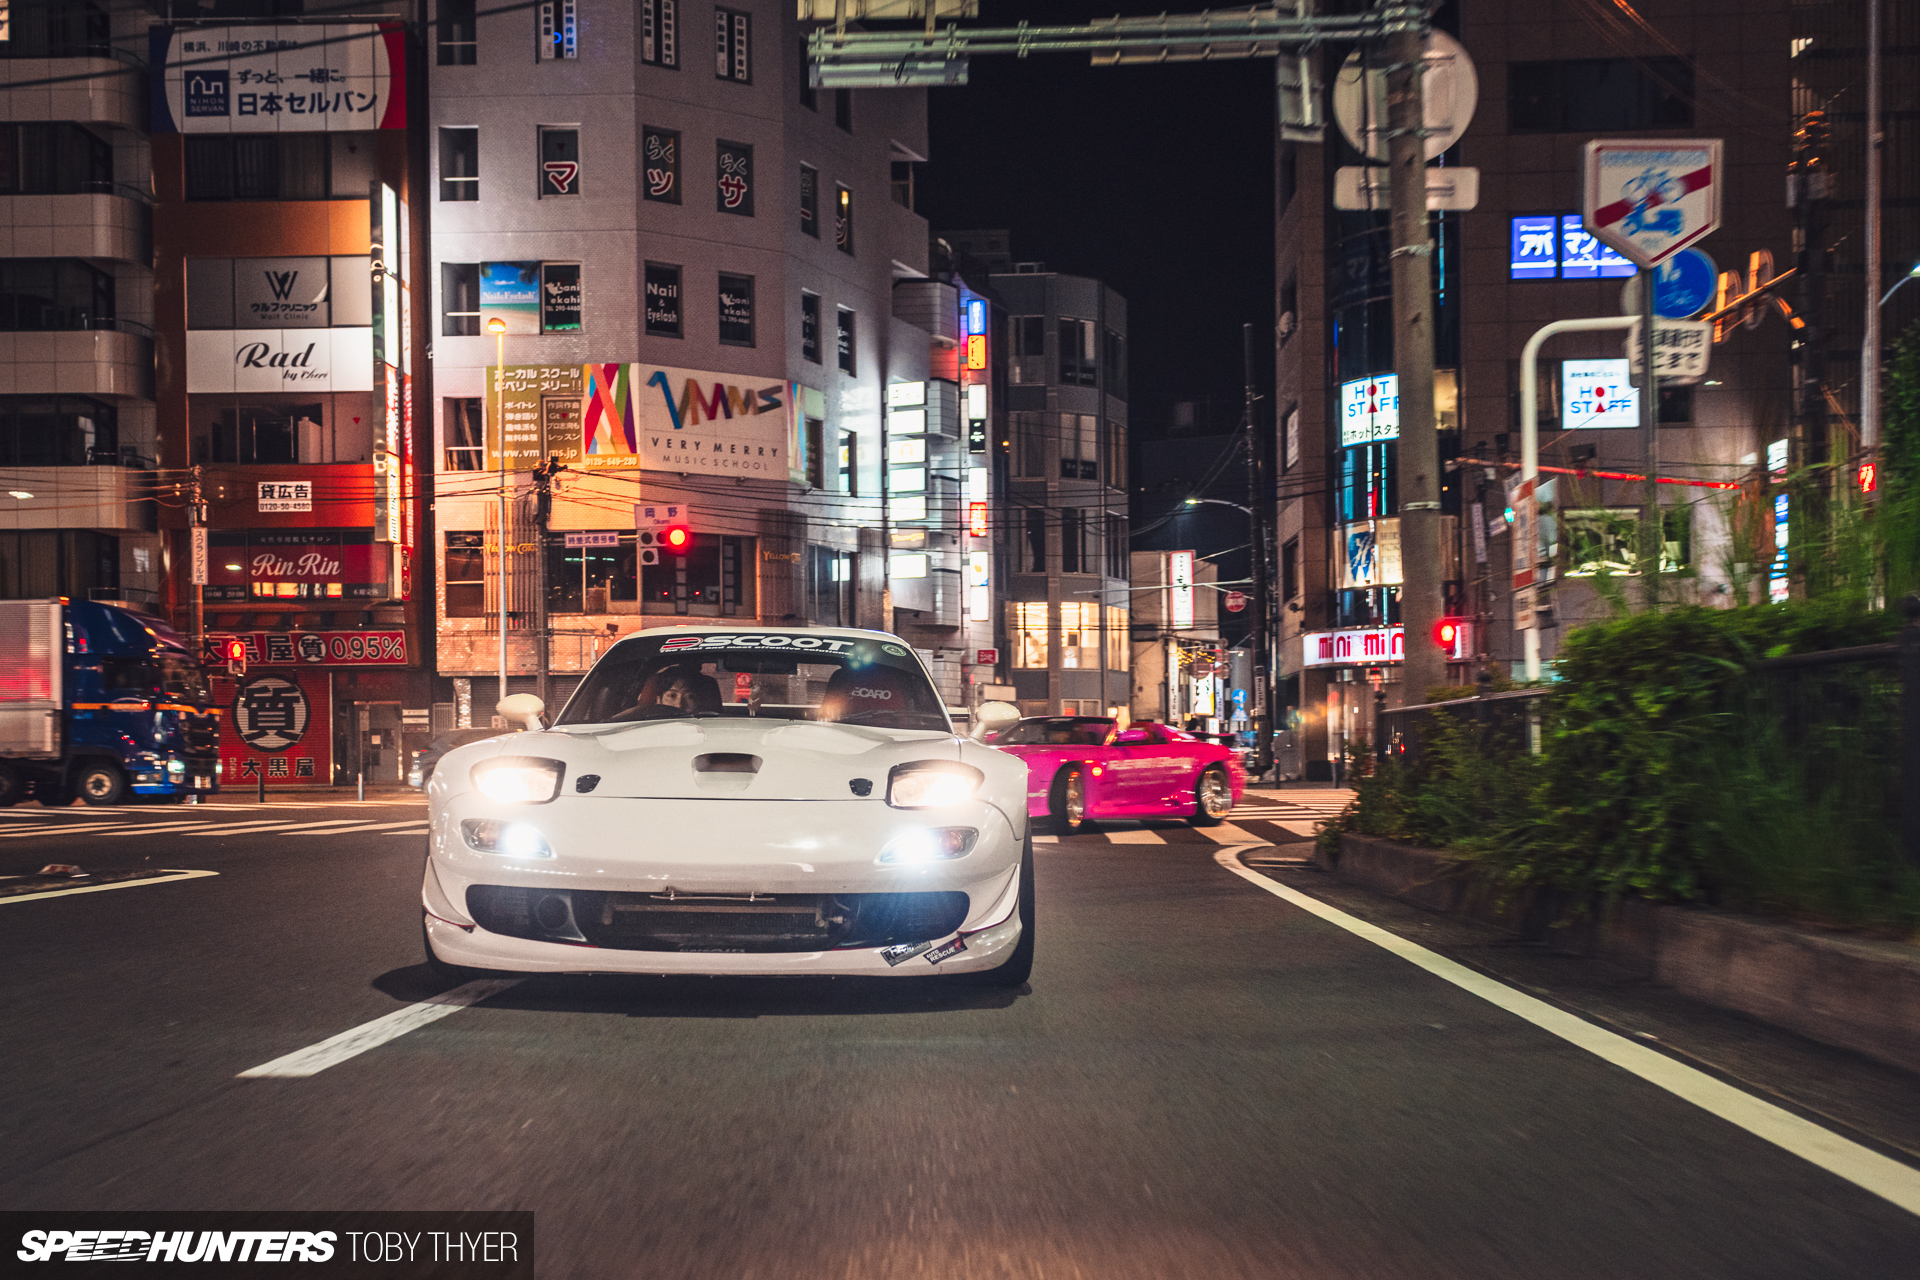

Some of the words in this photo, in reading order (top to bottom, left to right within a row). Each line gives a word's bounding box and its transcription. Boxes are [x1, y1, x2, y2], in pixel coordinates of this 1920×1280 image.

[238, 68, 346, 84] ずっと、一緒に。
[190, 105, 225, 113] SERVAN
[238, 91, 378, 116] 日本セルバン
[718, 174, 748, 208] サ
[646, 282, 678, 298] Nail
[251, 302, 318, 313] ウルフクリニック
[647, 307, 678, 323] Eyelash
[236, 342, 317, 369] Rad
[283, 369, 298, 381] by
[540, 368, 580, 379] スクール
[1354, 380, 1390, 400] HOT
[1580, 385, 1618, 399] HOT
[1570, 399, 1632, 414] STAFF
[651, 437, 702, 451] VERY
[713, 443, 778, 457] MERRY
[662, 455, 707, 466] MUSIC
[713, 459, 768, 471] SCHOOL
[260, 484, 309, 499] 貸広告
[644, 506, 678, 518] 岡野
[484, 543, 517, 554] YELOW
[251, 553, 296, 576] Rin
[297, 552, 341, 576] Rin
[330, 635, 404, 660] 0.95%
[701, 635, 855, 651] SCOOT
[243, 684, 305, 744] 質
[241, 757, 315, 778] 大黒屋
[929, 946, 956, 962] RESCUE
